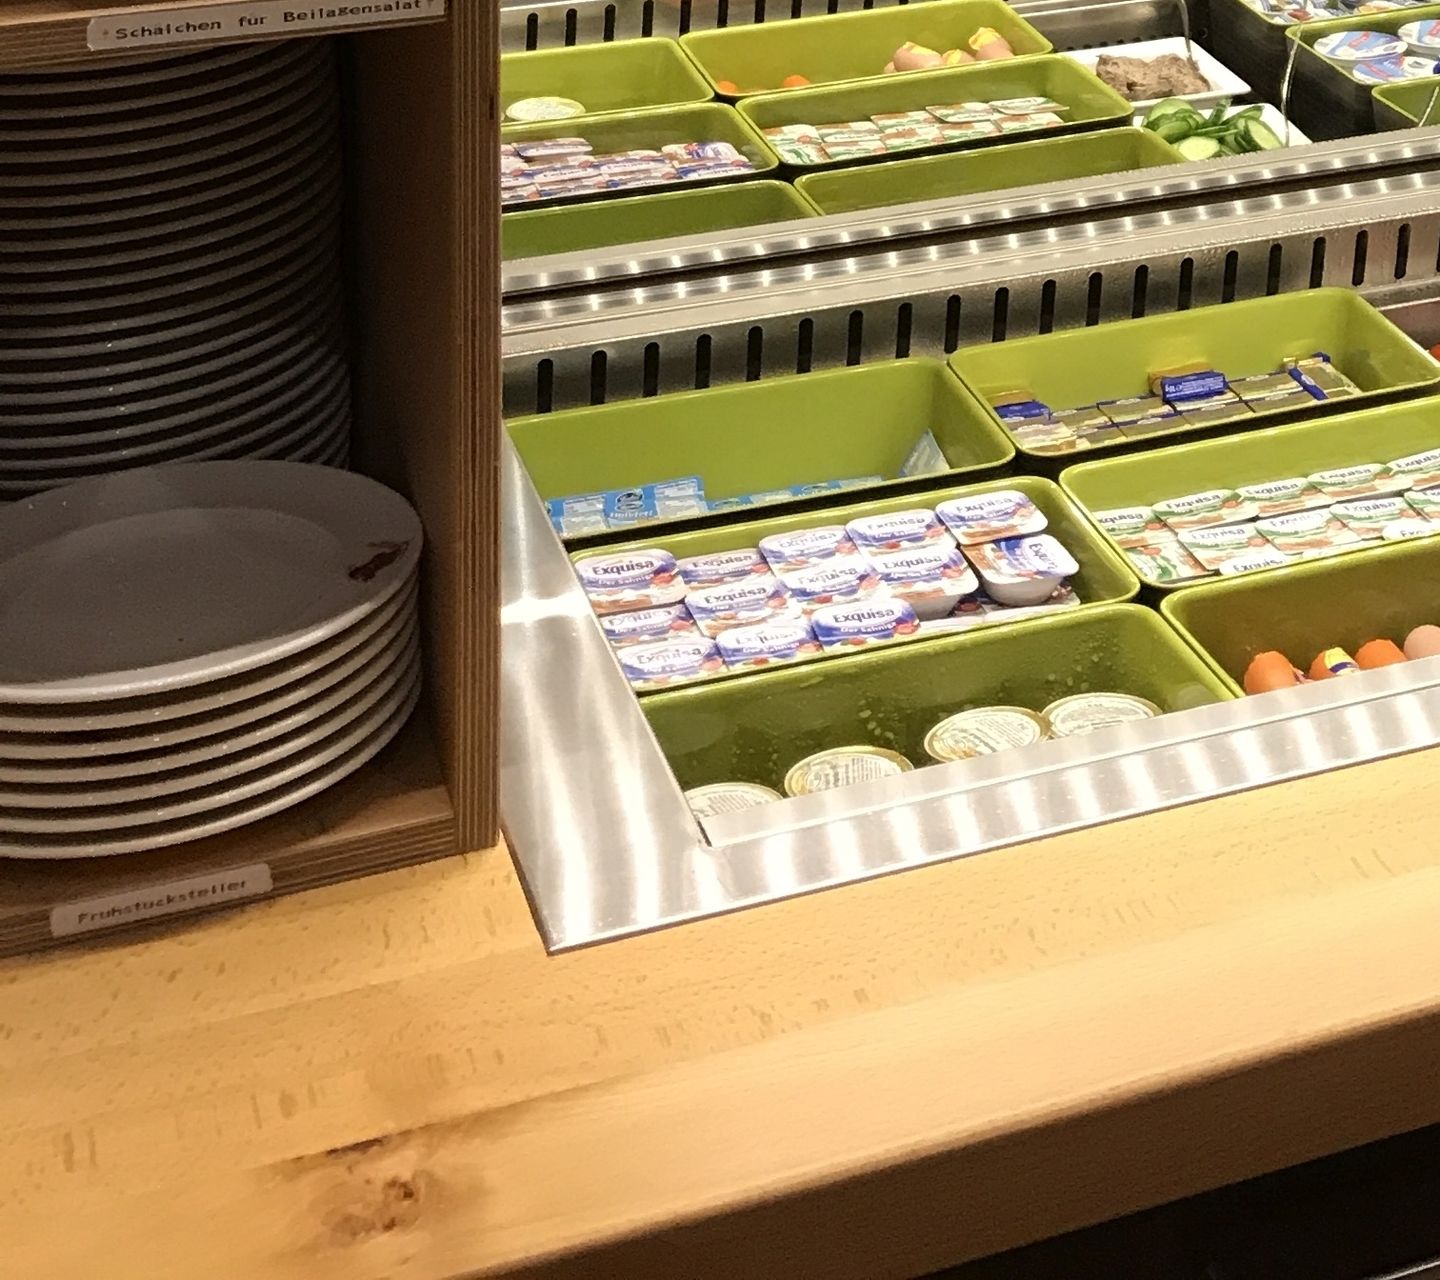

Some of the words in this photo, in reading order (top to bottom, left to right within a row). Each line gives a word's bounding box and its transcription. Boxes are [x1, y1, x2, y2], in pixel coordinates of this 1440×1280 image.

[592, 559, 654, 576] Exquisa
[704, 587, 768, 604] Exquisa
[833, 608, 896, 624] Exquisa
